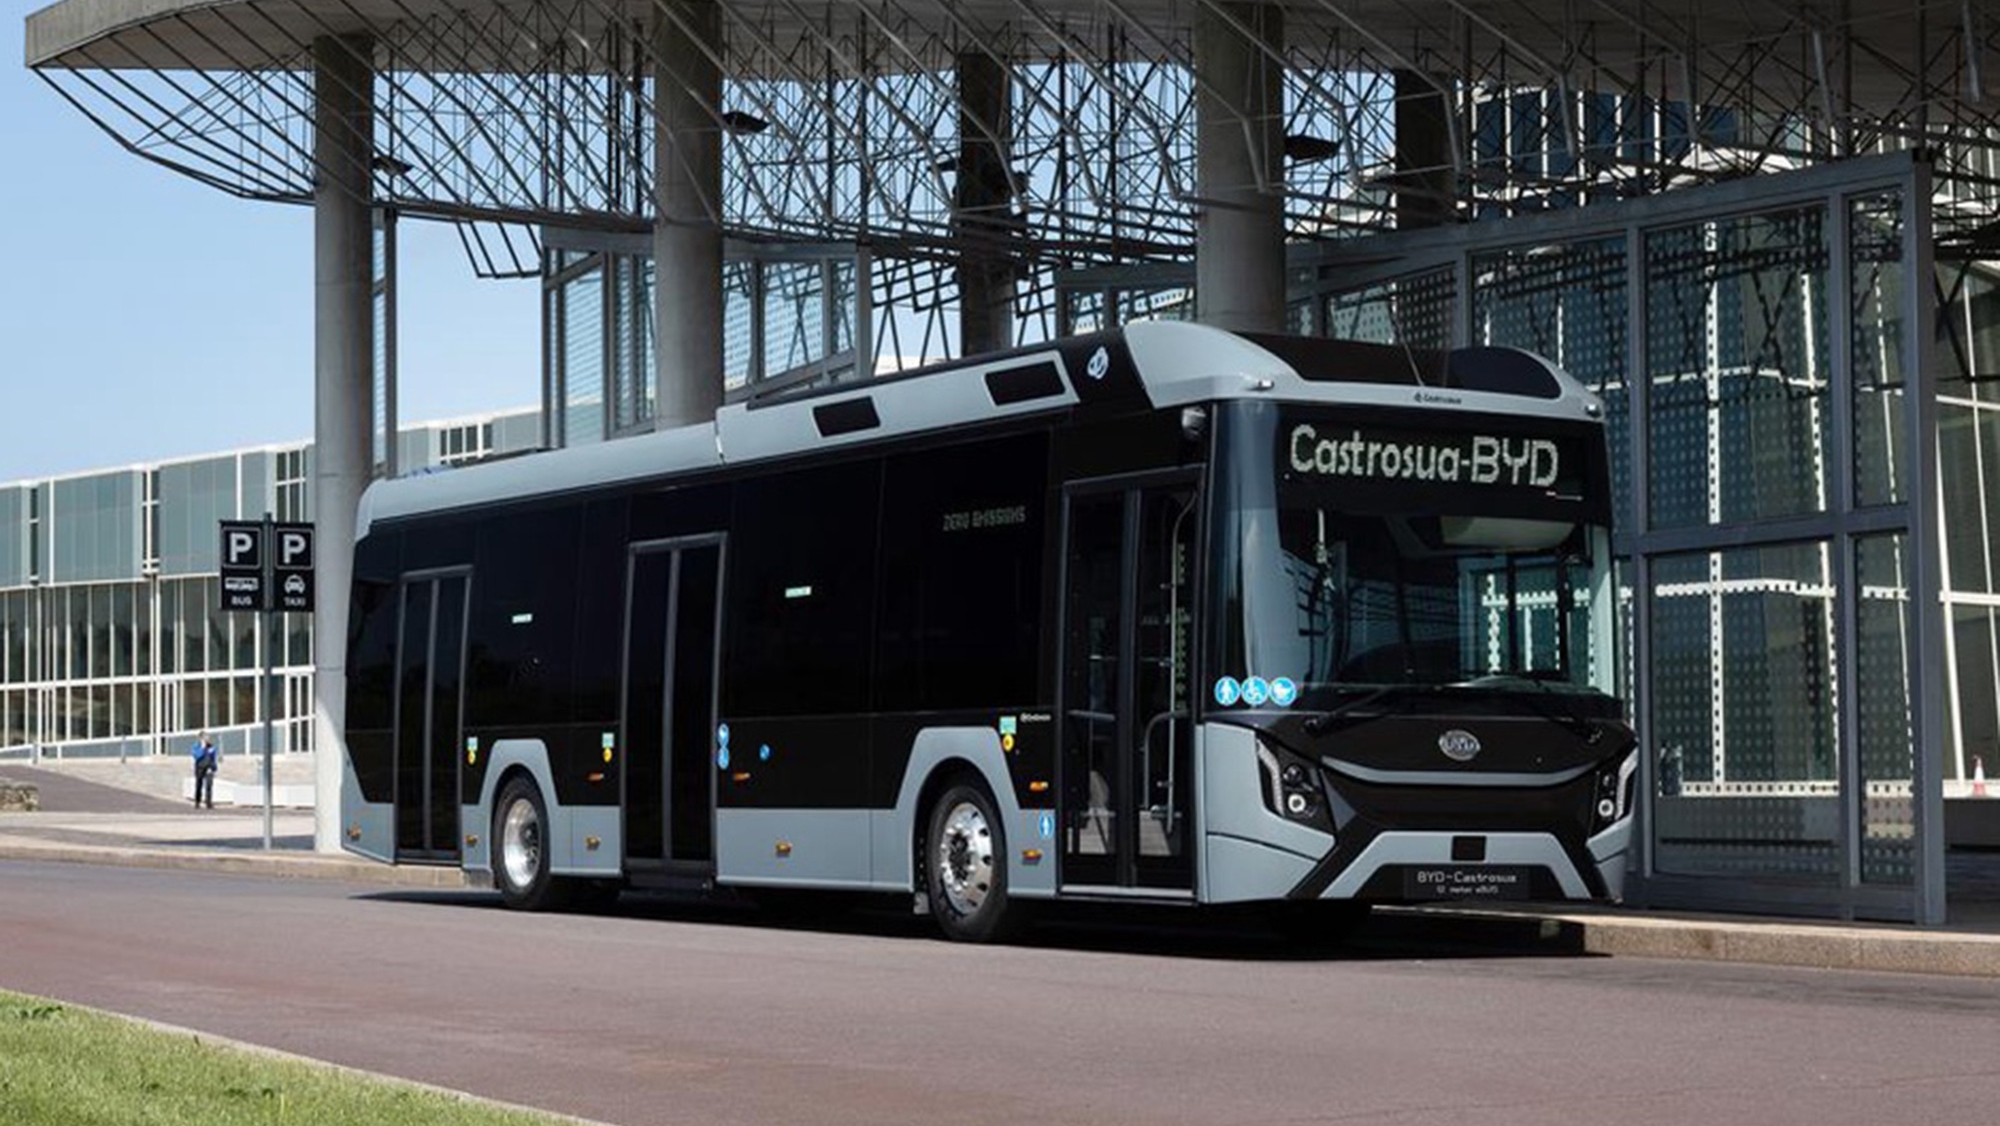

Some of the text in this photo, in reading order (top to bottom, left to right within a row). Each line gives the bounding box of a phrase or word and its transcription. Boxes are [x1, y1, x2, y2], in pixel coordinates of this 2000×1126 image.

[1290, 424, 1559, 487] Castrosua-BYD
[229, 532, 253, 563] P
[283, 534, 306, 564] P
[231, 596, 253, 605] BUS
[284, 597, 306, 607] TAXI
[1417, 870, 1517, 883] BYD-Castrosua
